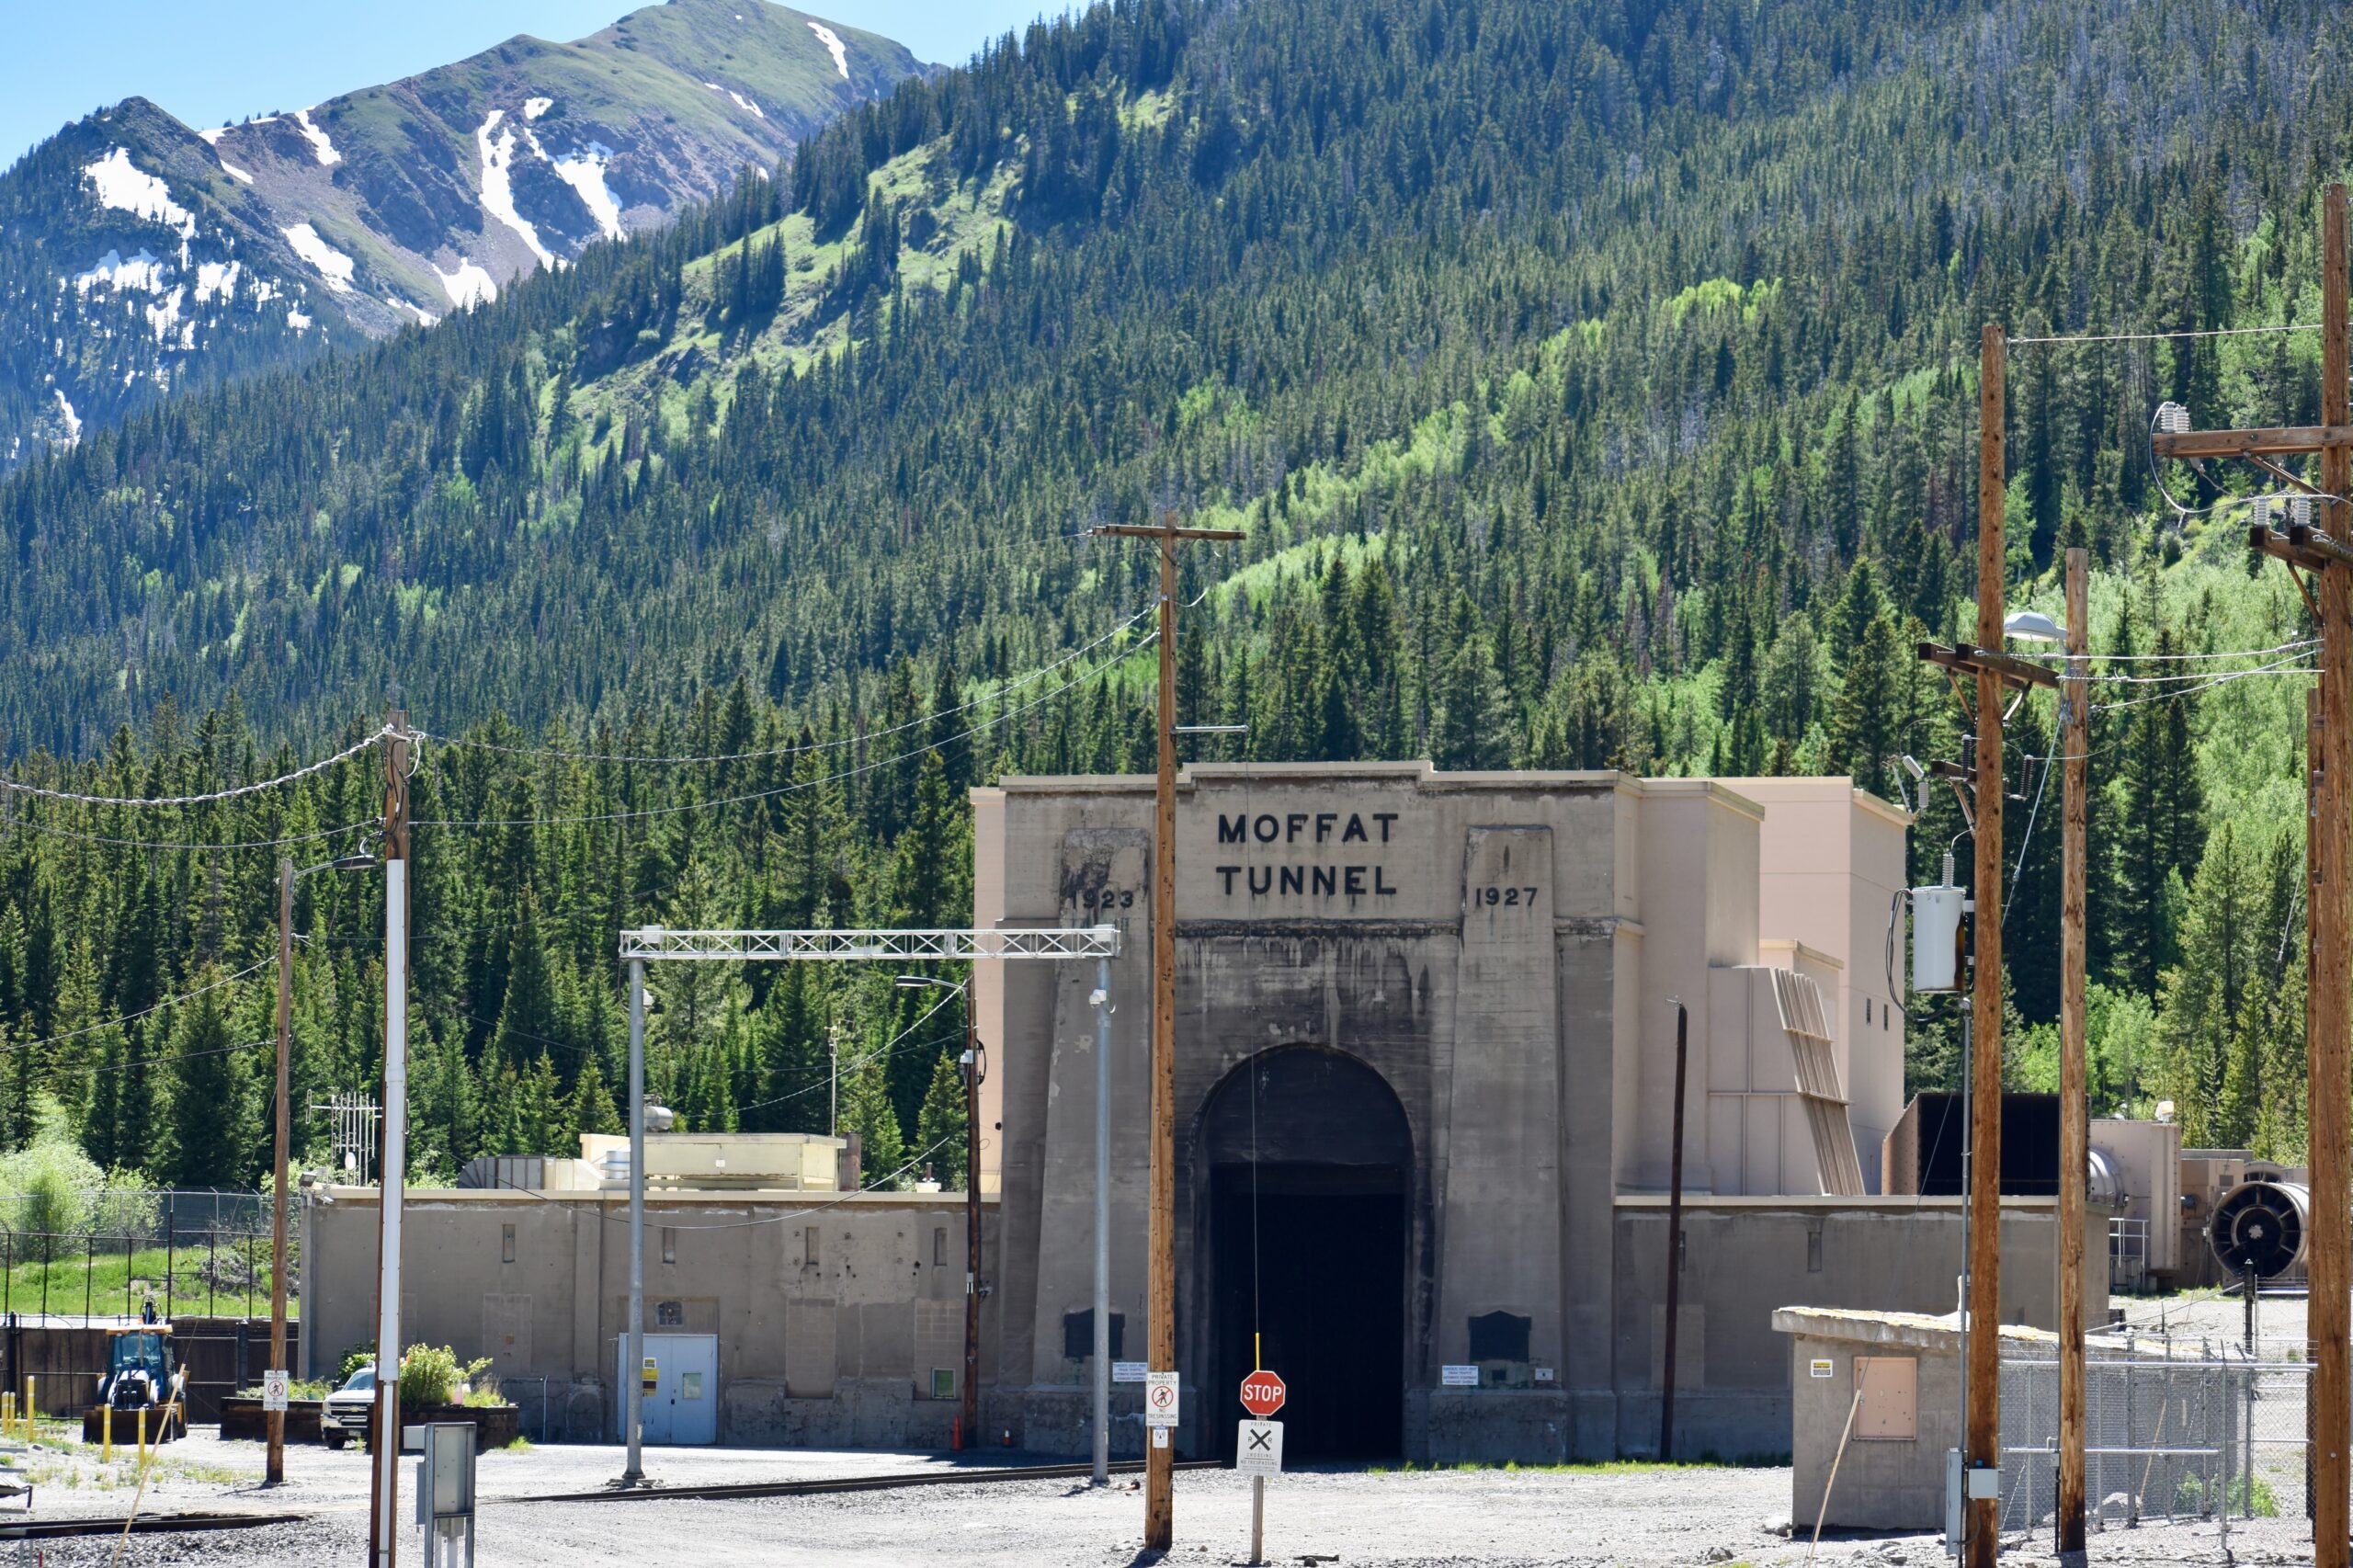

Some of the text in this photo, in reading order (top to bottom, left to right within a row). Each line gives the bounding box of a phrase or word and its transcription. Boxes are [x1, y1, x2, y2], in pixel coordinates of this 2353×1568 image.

[1218, 813, 1399, 843] MOFFAT
[1215, 866, 1397, 895] TUNNEL
[1072, 889, 1133, 909] 1923
[1475, 887, 1538, 906] 1927
[1244, 1384, 1283, 1403] STOP
